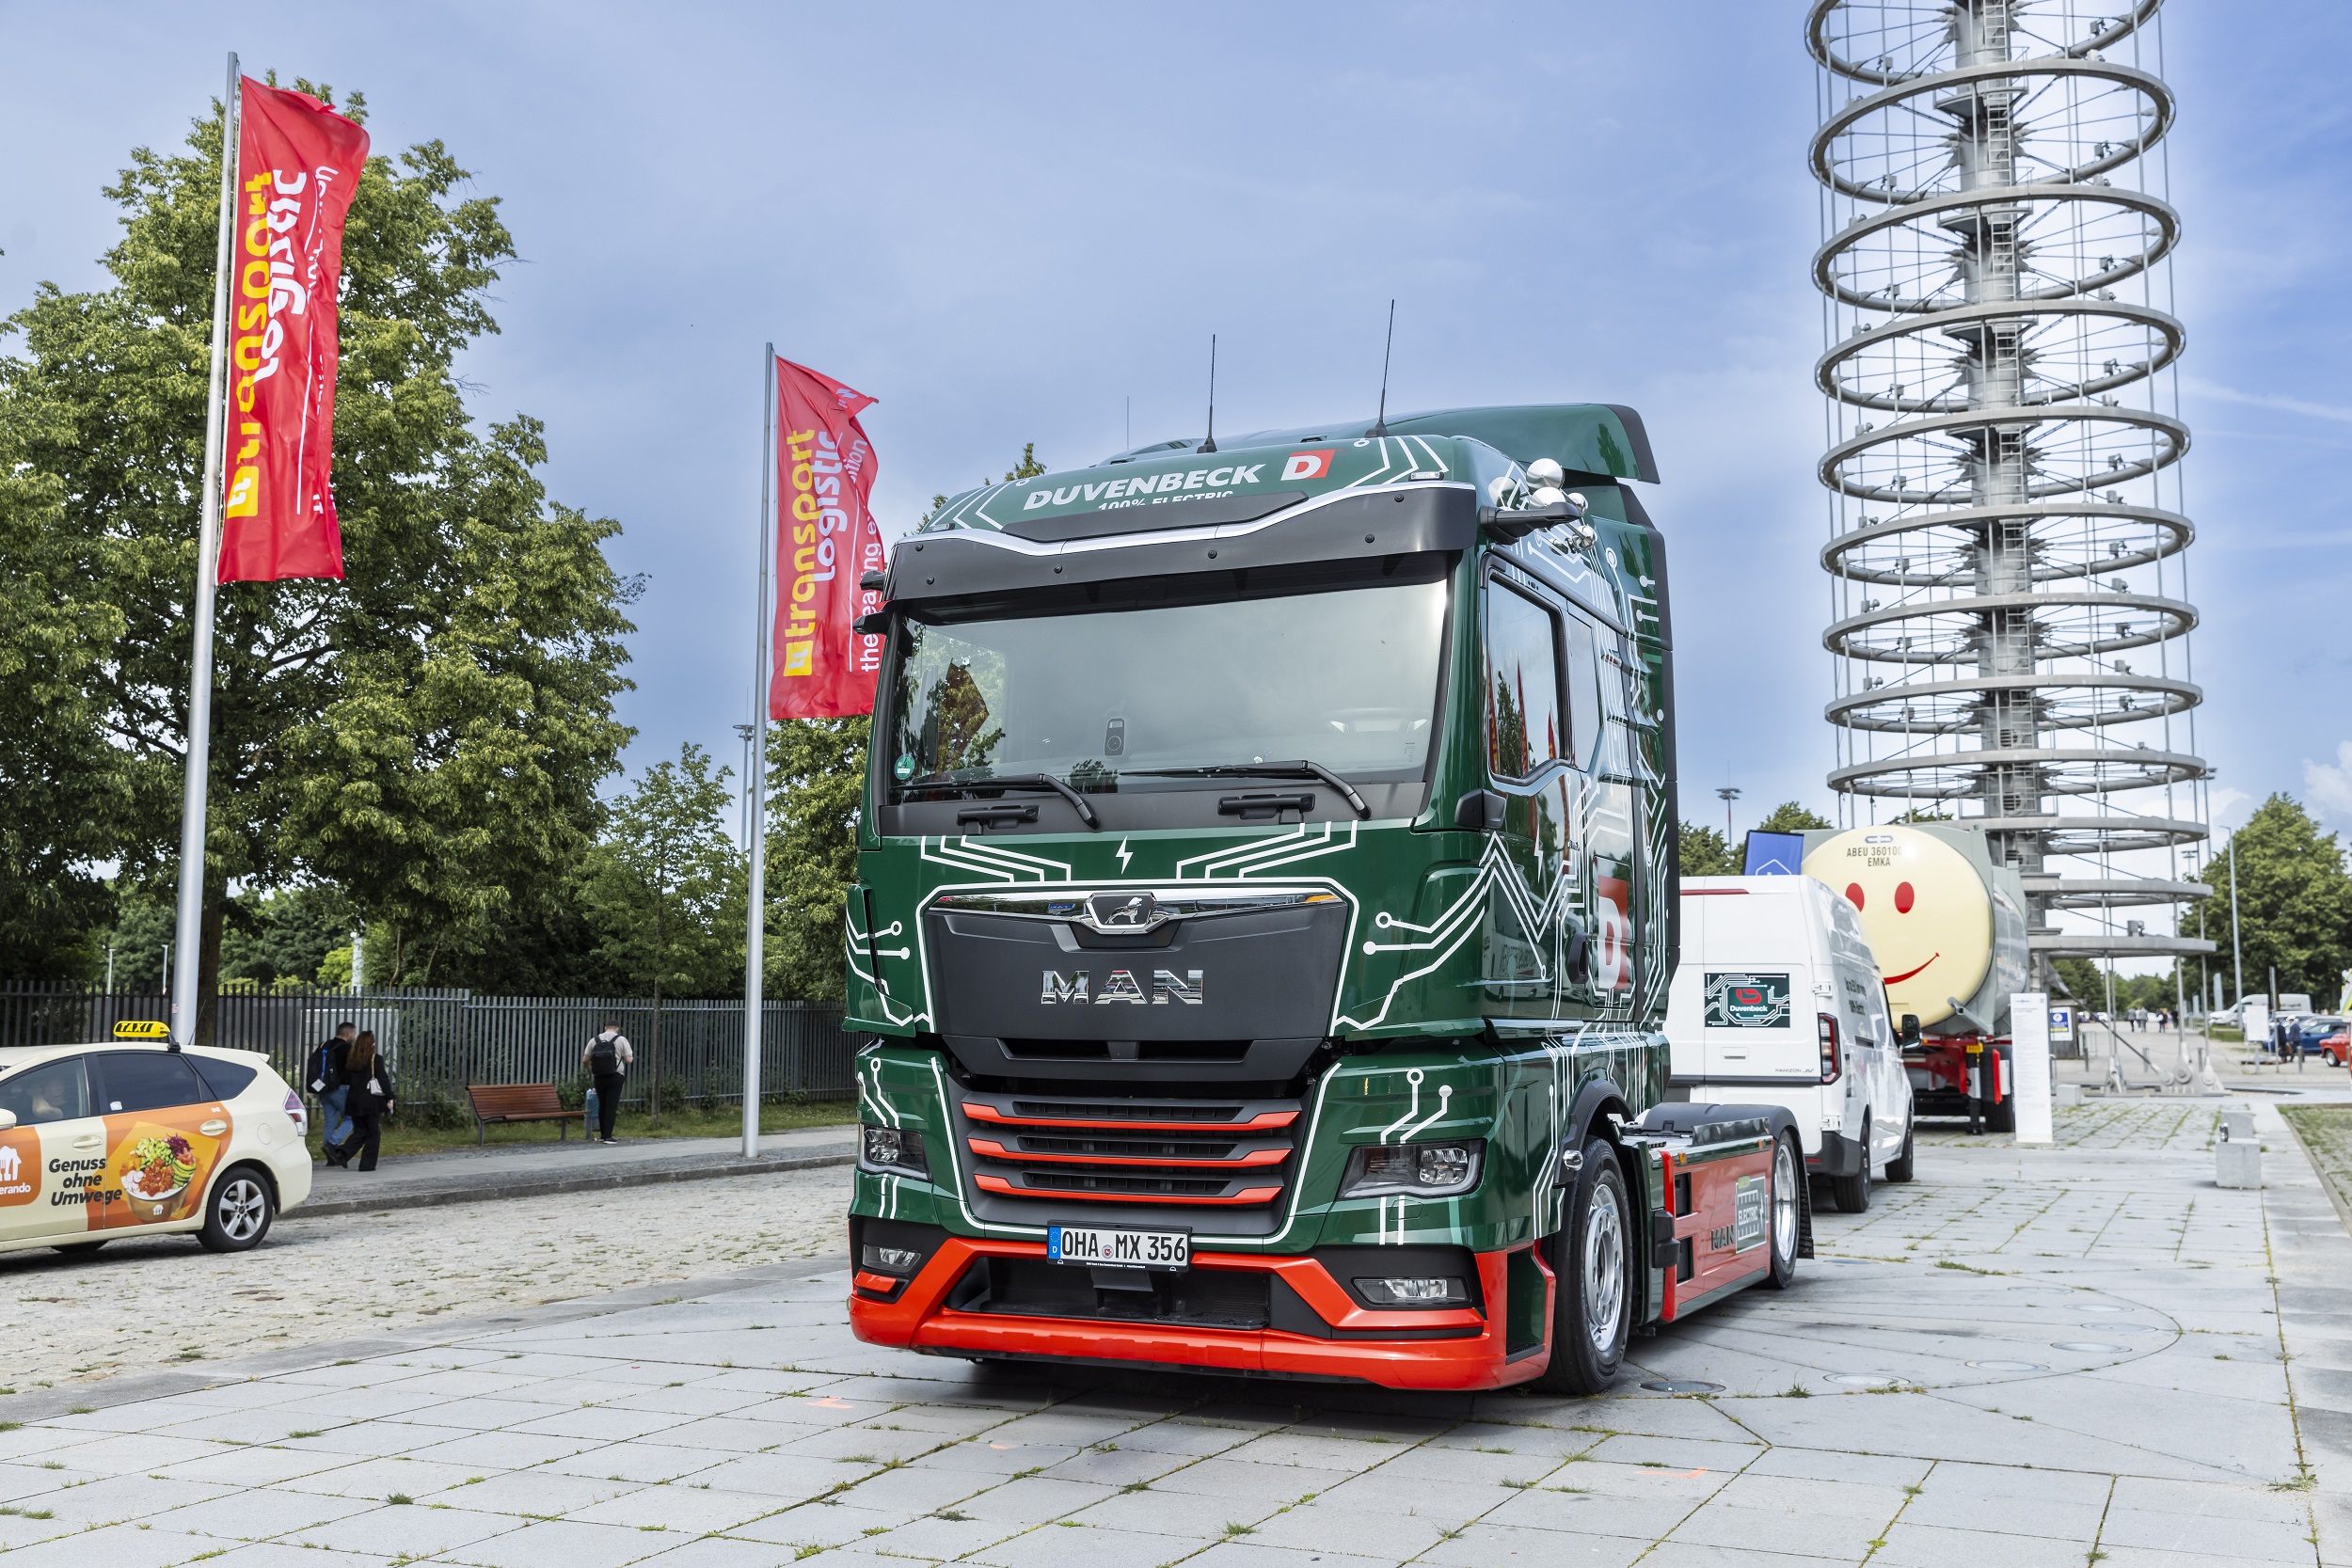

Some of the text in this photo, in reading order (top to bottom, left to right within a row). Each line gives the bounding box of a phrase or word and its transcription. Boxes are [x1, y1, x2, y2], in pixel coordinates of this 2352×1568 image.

[1023, 454, 1323, 511] DUVENBECK D
[809, 431, 848, 582] logistic
[785, 428, 822, 638] transport
[860, 633, 880, 672] the
[1847, 847, 1868, 857] ABEU
[1867, 857, 1891, 866] EMKA
[1597, 895, 1623, 989] D
[1041, 970, 1204, 1005] MAN
[119, 1022, 151, 1033] TAXI
[49, 1158, 106, 1173] Genuss
[63, 1173, 103, 1188] ohne
[51, 1189, 122, 1206] Umwege
[1738, 1206, 1758, 1226] ELECTRIC
[1062, 1230, 1099, 1258] OHA
[1115, 1234, 1141, 1259] MX
[1147, 1235, 1186, 1261] 356
[1710, 1224, 1734, 1251] MAN
